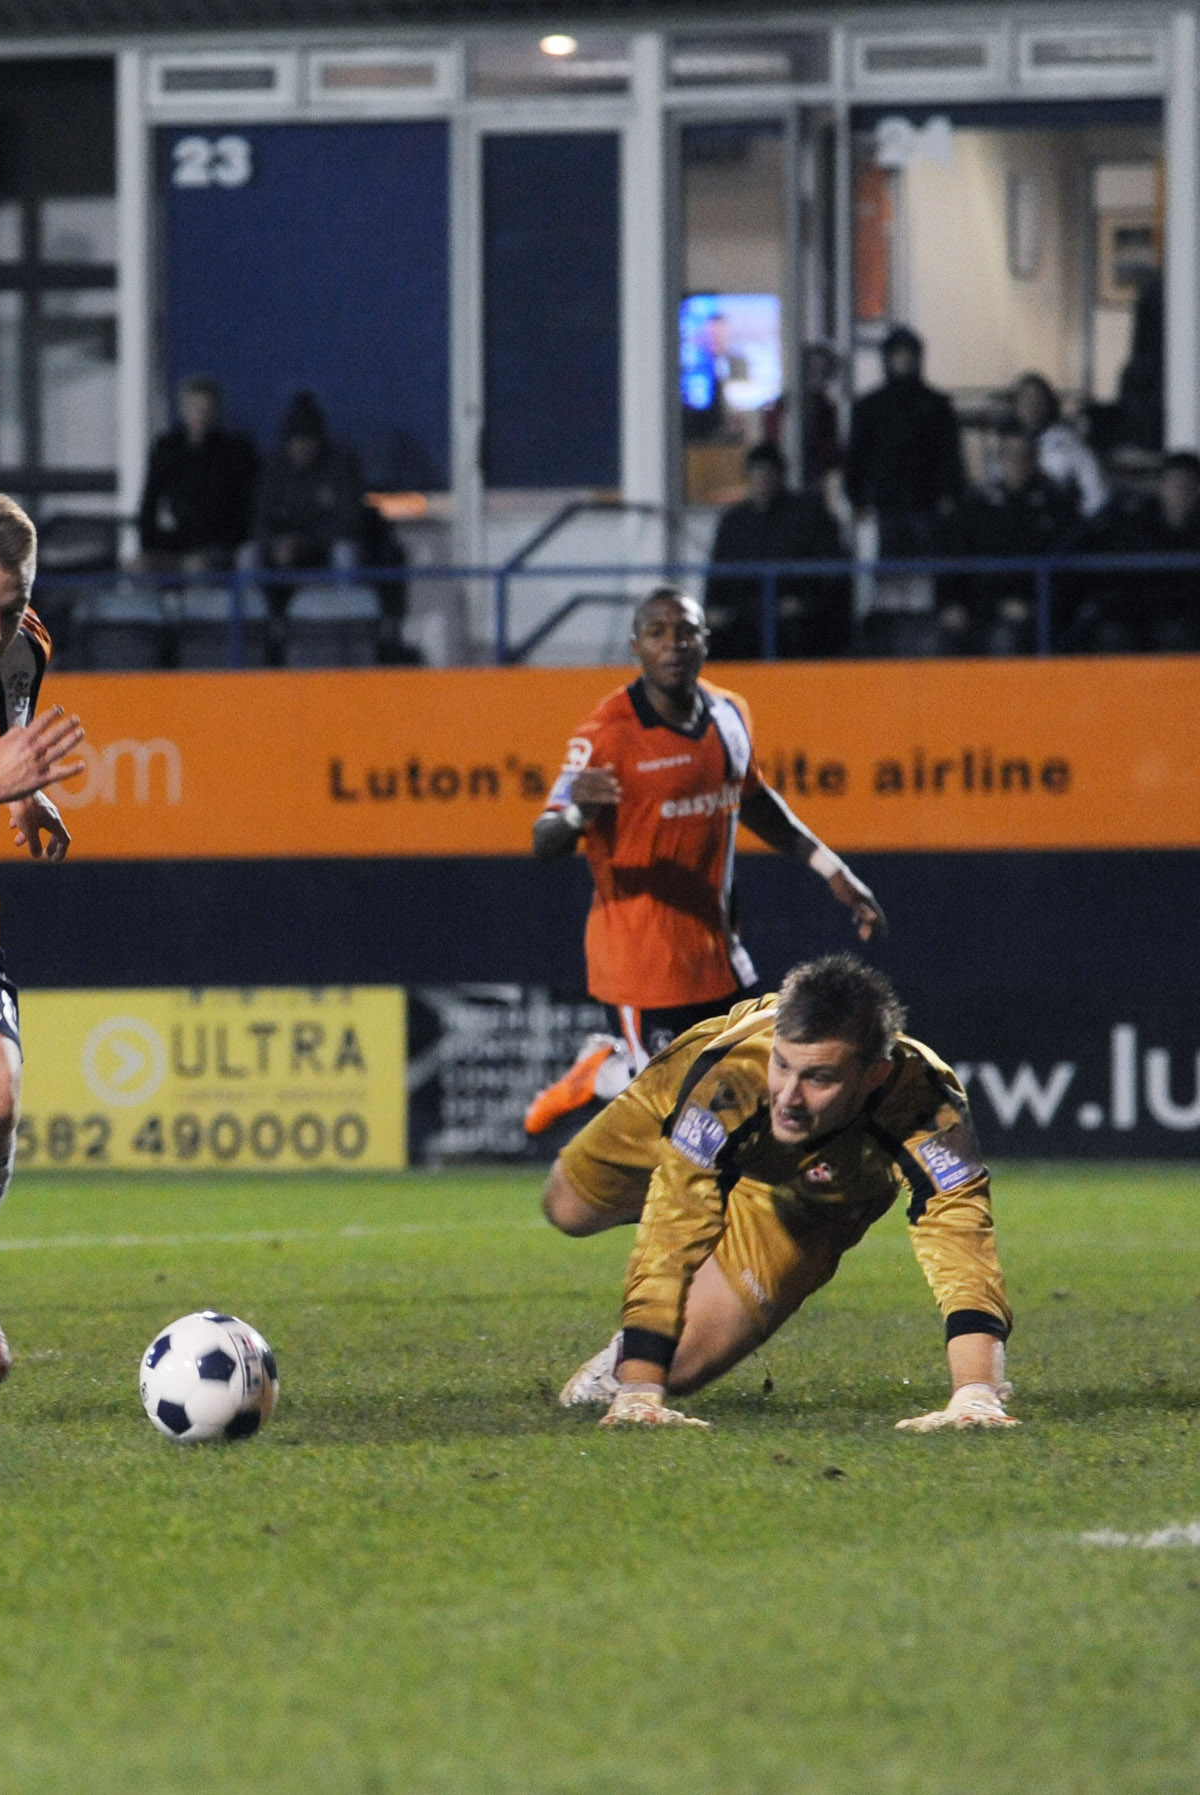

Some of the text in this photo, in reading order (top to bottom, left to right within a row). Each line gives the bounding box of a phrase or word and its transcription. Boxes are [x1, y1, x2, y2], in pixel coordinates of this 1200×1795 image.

[172, 135, 252, 189] 23
[329, 755, 548, 803] Luton's
[874, 747, 1072, 797] airline
[169, 1019, 370, 1080] ULTRA
[130, 1111, 371, 1162] 490000
